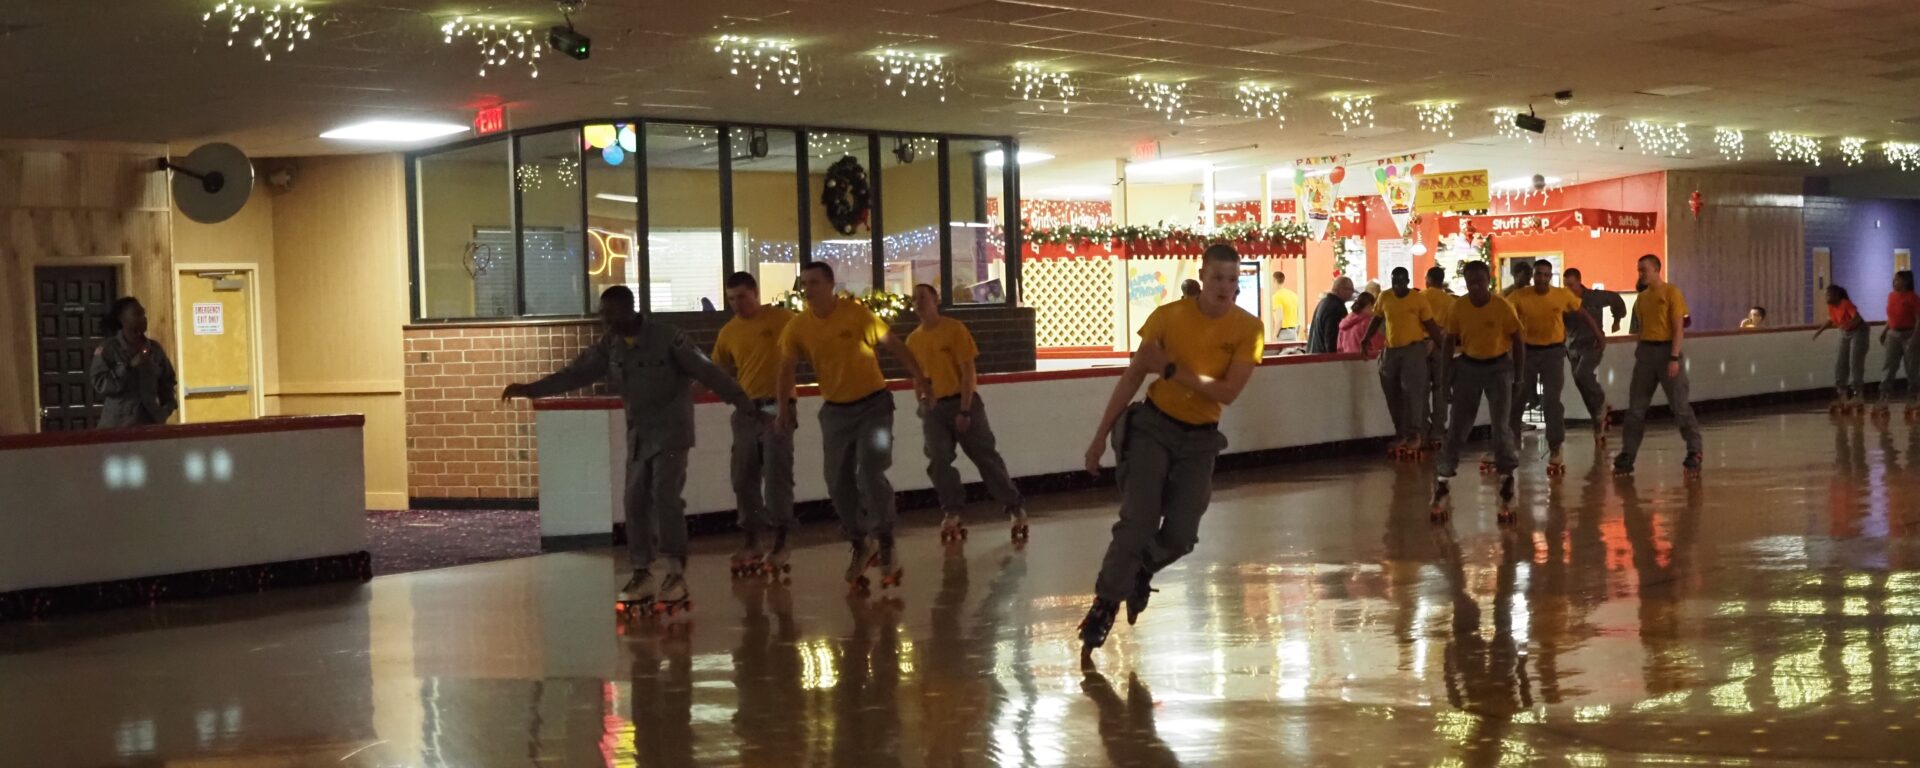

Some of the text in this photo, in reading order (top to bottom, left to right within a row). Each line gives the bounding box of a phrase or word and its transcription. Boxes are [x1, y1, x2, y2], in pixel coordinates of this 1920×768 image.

[480, 107, 503, 134] EXIT
[1377, 152, 1417, 166] PARTY
[1418, 174, 1487, 192] SNACK
[1432, 189, 1474, 203] BAR
[1492, 216, 1550, 230] Stuff Shp
